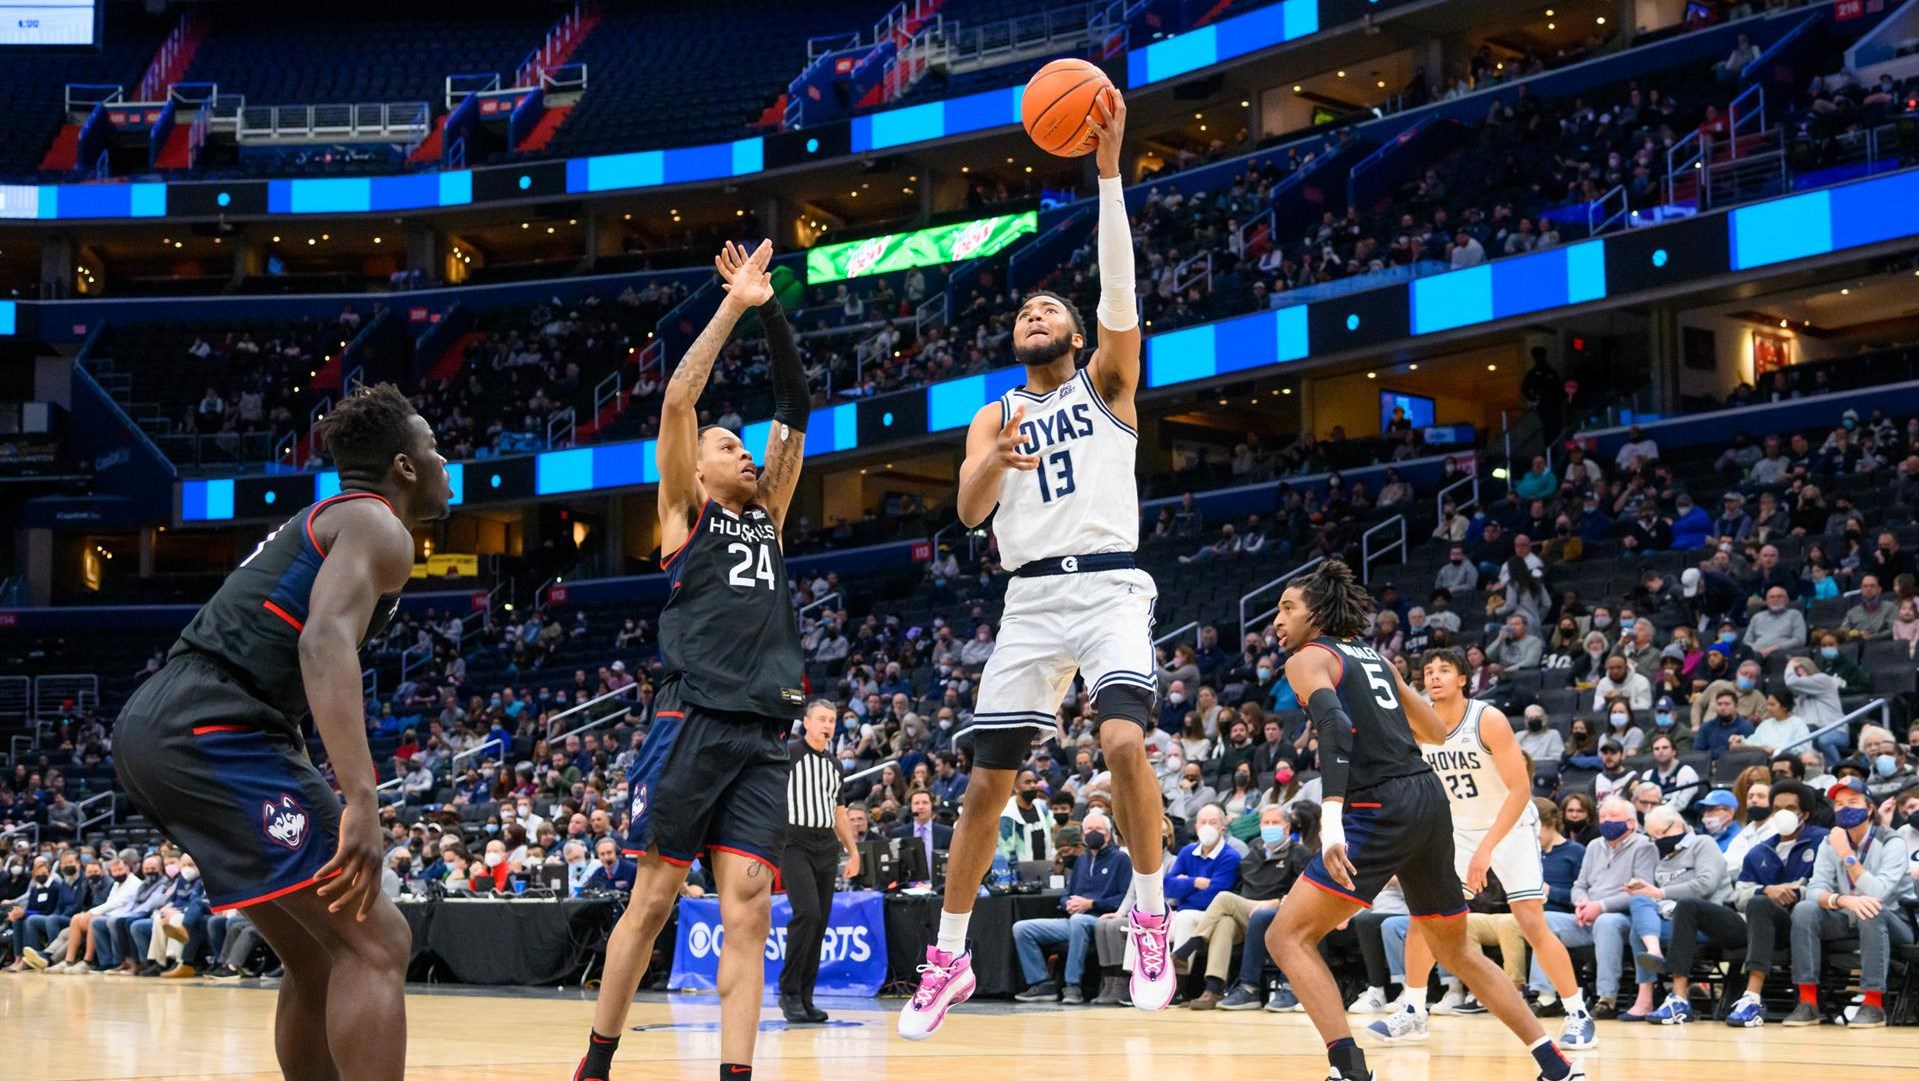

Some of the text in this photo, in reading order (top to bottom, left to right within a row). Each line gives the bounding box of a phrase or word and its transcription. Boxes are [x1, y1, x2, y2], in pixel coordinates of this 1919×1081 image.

[1015, 403, 1094, 455] OYAS
[1037, 450, 1076, 502] 13
[728, 542, 775, 590] 24
[1361, 662, 1399, 709] 5
[1426, 751, 1481, 771] HOYAS
[1445, 773, 1478, 799] 23
